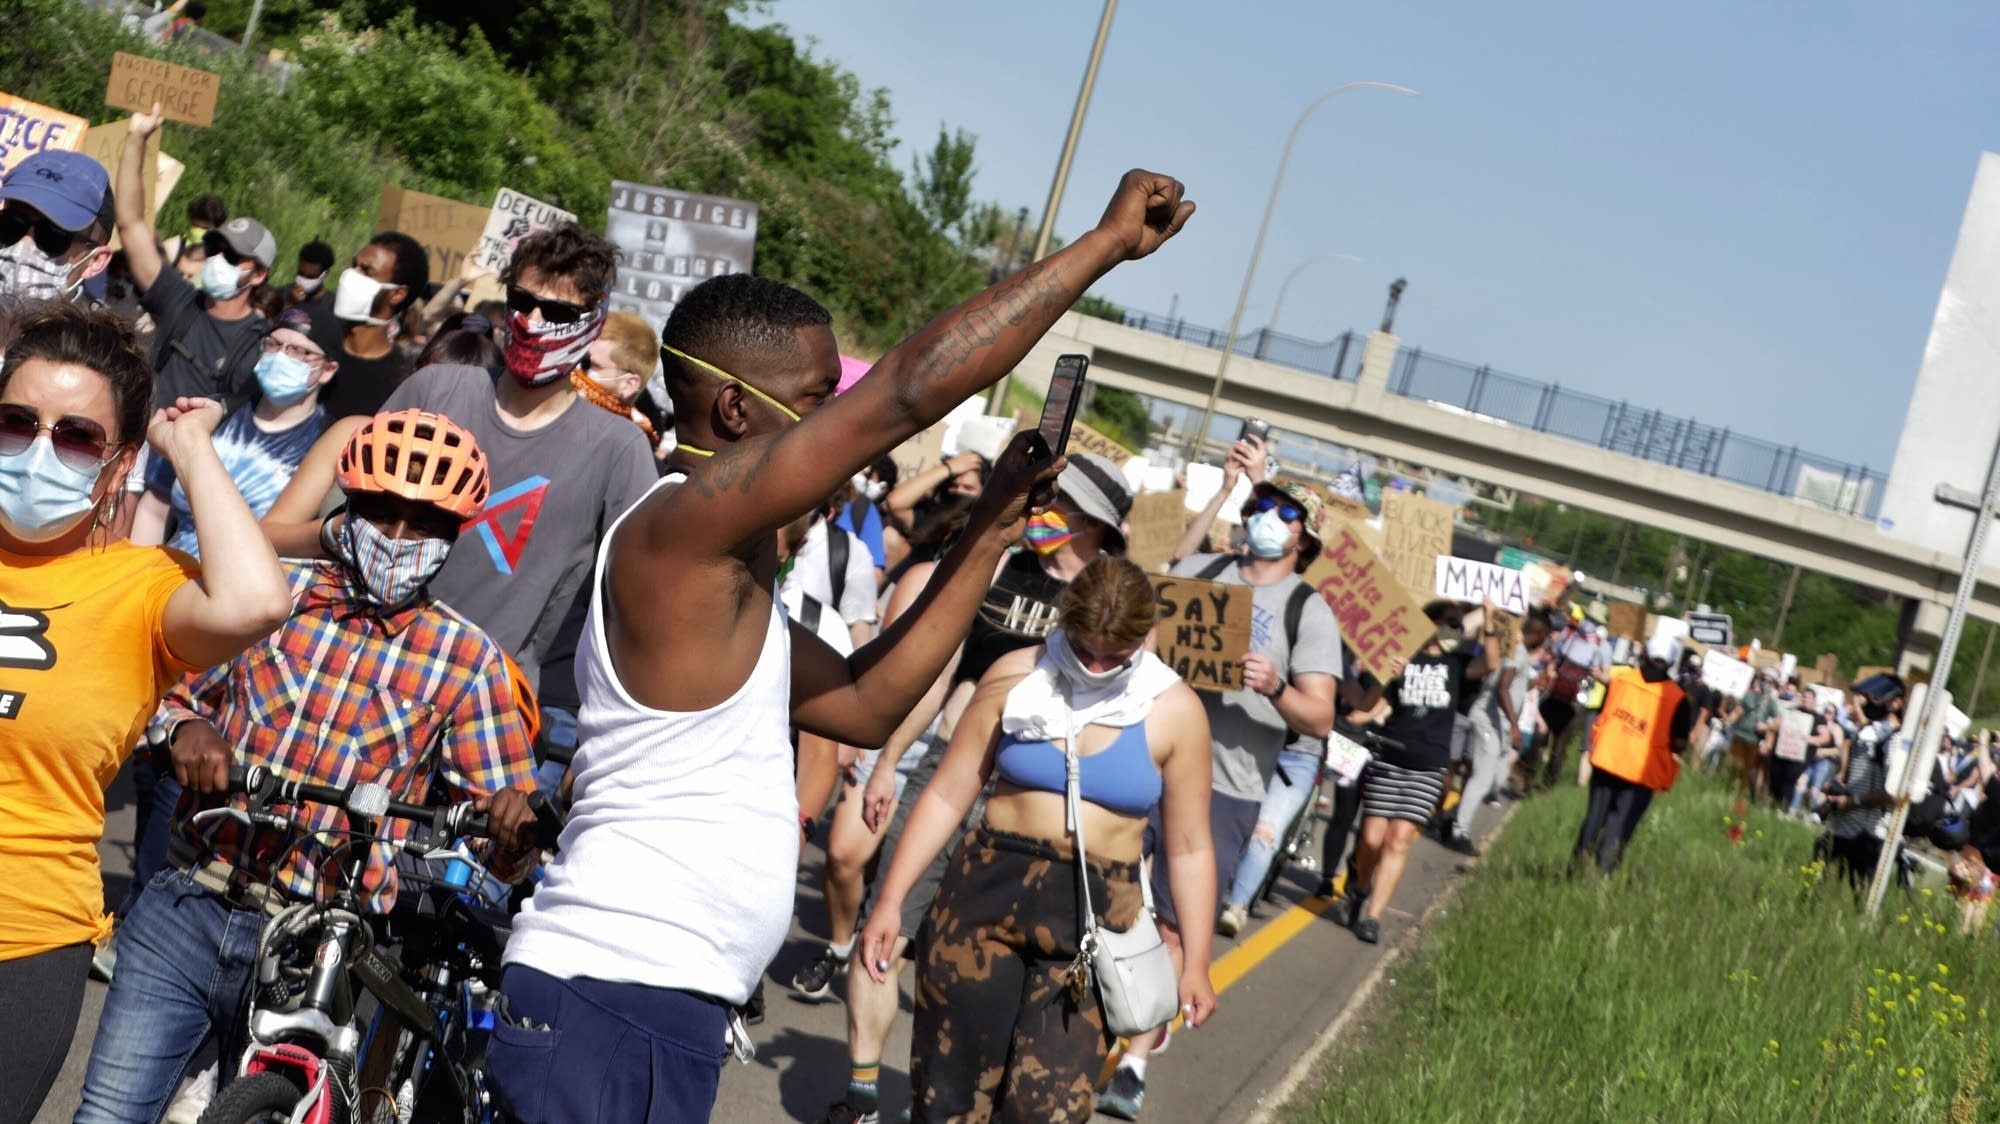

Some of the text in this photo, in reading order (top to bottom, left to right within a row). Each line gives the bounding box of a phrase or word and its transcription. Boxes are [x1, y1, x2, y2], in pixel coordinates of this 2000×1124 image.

[117, 55, 209, 88] JUSTICE FOR
[125, 78, 201, 117] GEORGE
[499, 192, 573, 226] DEFUN
[614, 189, 743, 227] JUSTICE
[484, 236, 507, 254] THE
[1156, 581, 1230, 624] SAY
[1444, 559, 1525, 611] MAMA
[1176, 624, 1222, 651] HIS
